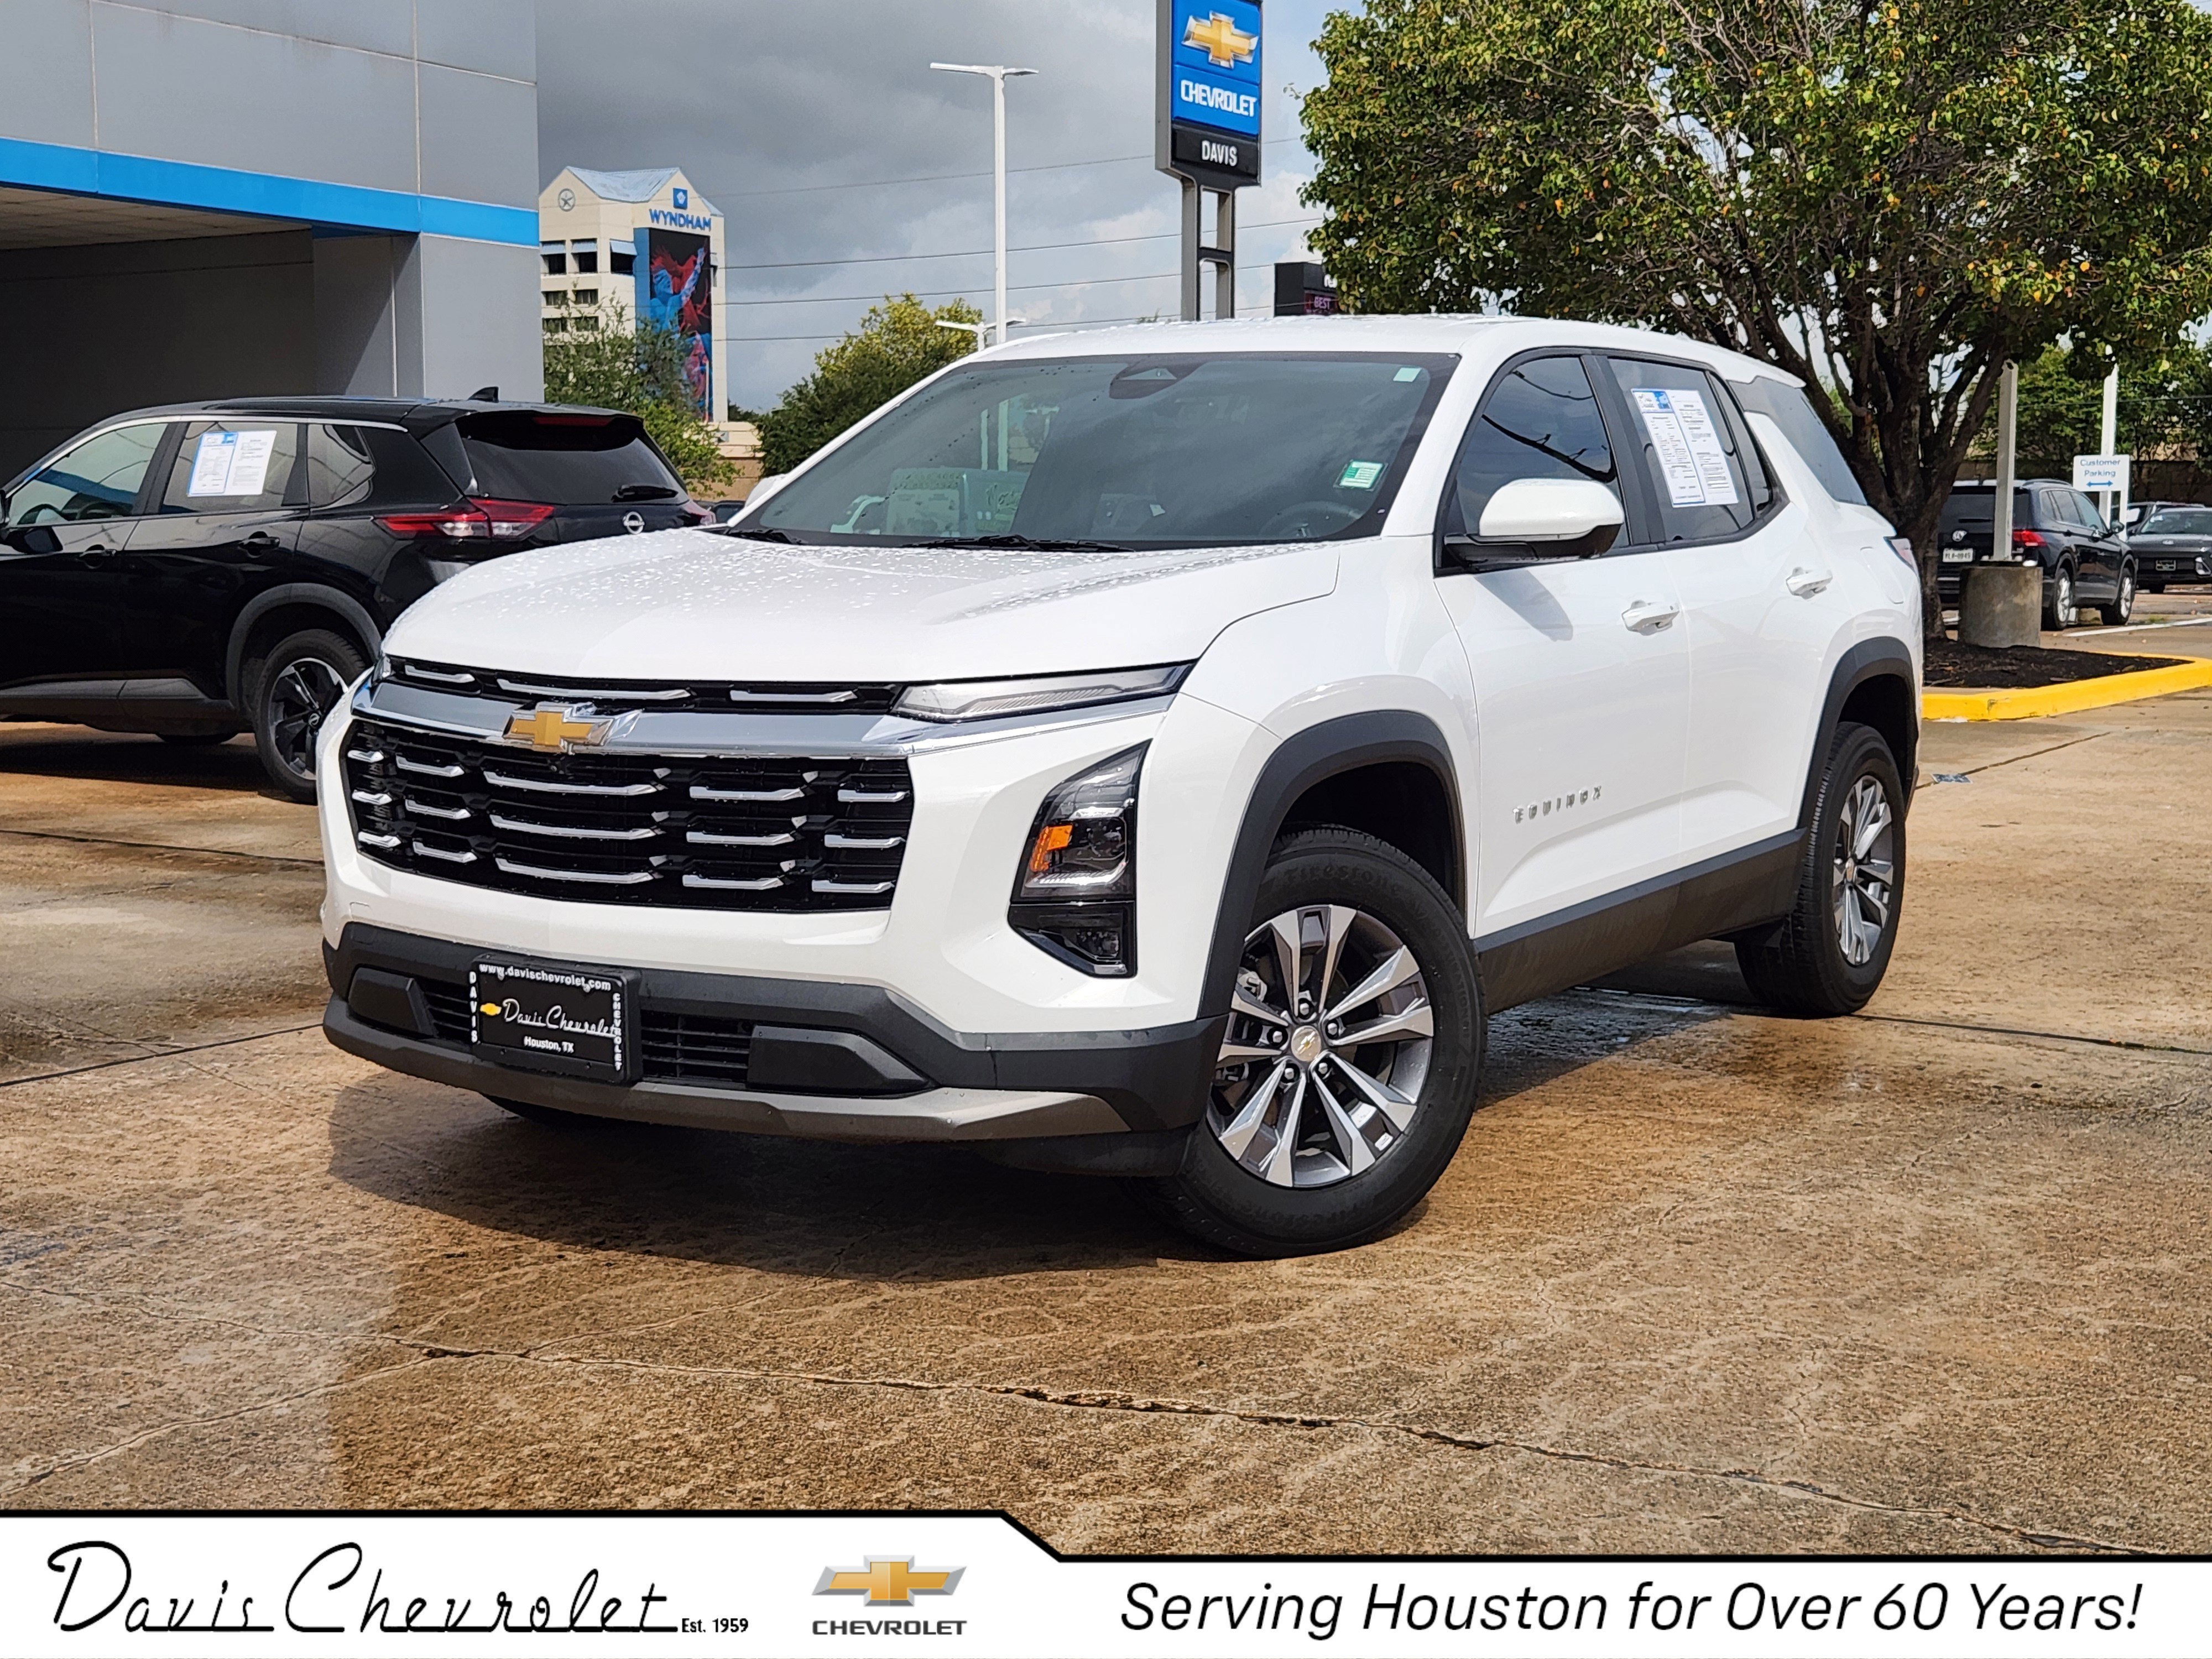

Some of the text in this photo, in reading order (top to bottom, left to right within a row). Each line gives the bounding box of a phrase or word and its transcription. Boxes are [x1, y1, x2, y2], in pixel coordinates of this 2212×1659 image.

[1181, 79, 1257, 117] CHEVROLET
[1202, 140, 1238, 166] DAVIS
[649, 208, 711, 231] WYNDHAM
[1314, 296, 1332, 309] BEST
[2084, 469, 2116, 478] Parking
[1514, 785, 1601, 824] EQUINOX
[479, 964, 611, 992] www.davischevrolet.com
[469, 971, 478, 1043] DAVIS
[502, 998, 617, 1038] Davis Chevrolet
[523, 1035, 575, 1053] Houston, TX
[613, 992, 622, 1071] CHEVROLET
